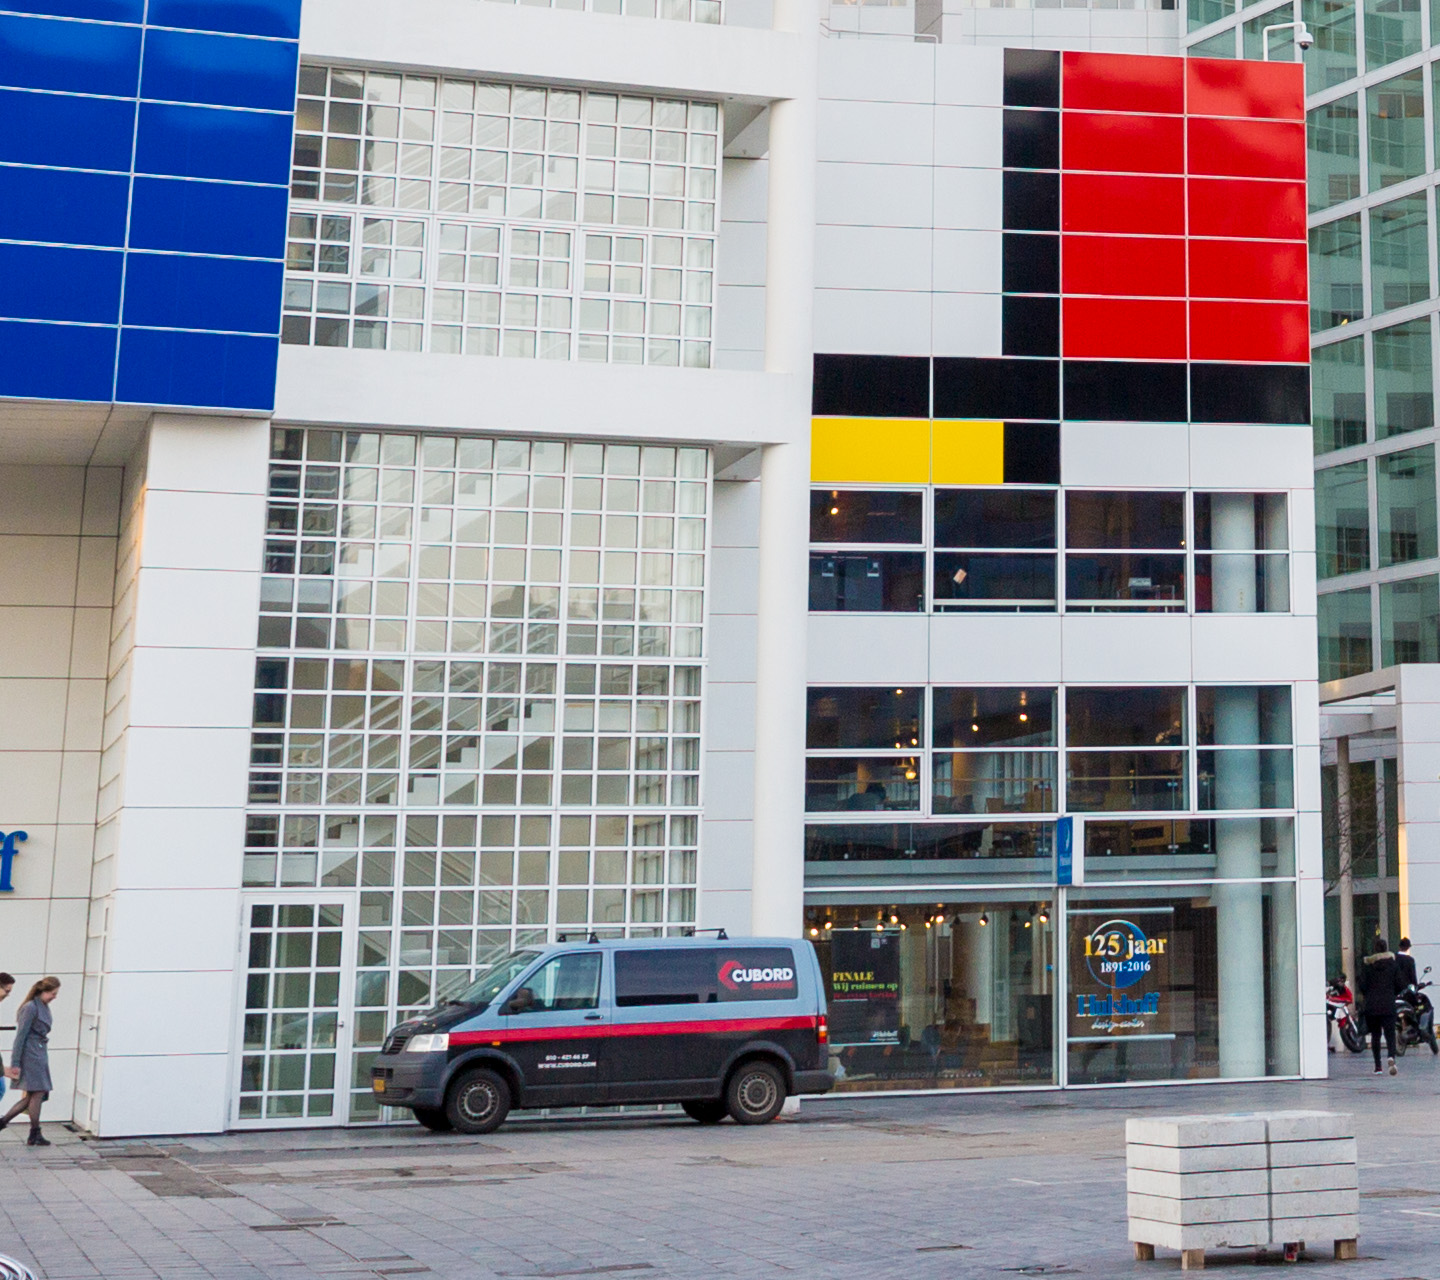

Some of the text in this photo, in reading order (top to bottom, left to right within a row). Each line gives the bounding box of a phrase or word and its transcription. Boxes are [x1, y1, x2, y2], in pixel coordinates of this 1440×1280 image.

[1083, 933, 1167, 959] 125 jaar
[1100, 960, 1151, 973] 1891-2016
[732, 967, 794, 983] CUBORD
[833, 972, 875, 982] FINALE
[833, 982, 899, 992] Wij ruimen op
[1076, 992, 1160, 1017] Hulshoff
